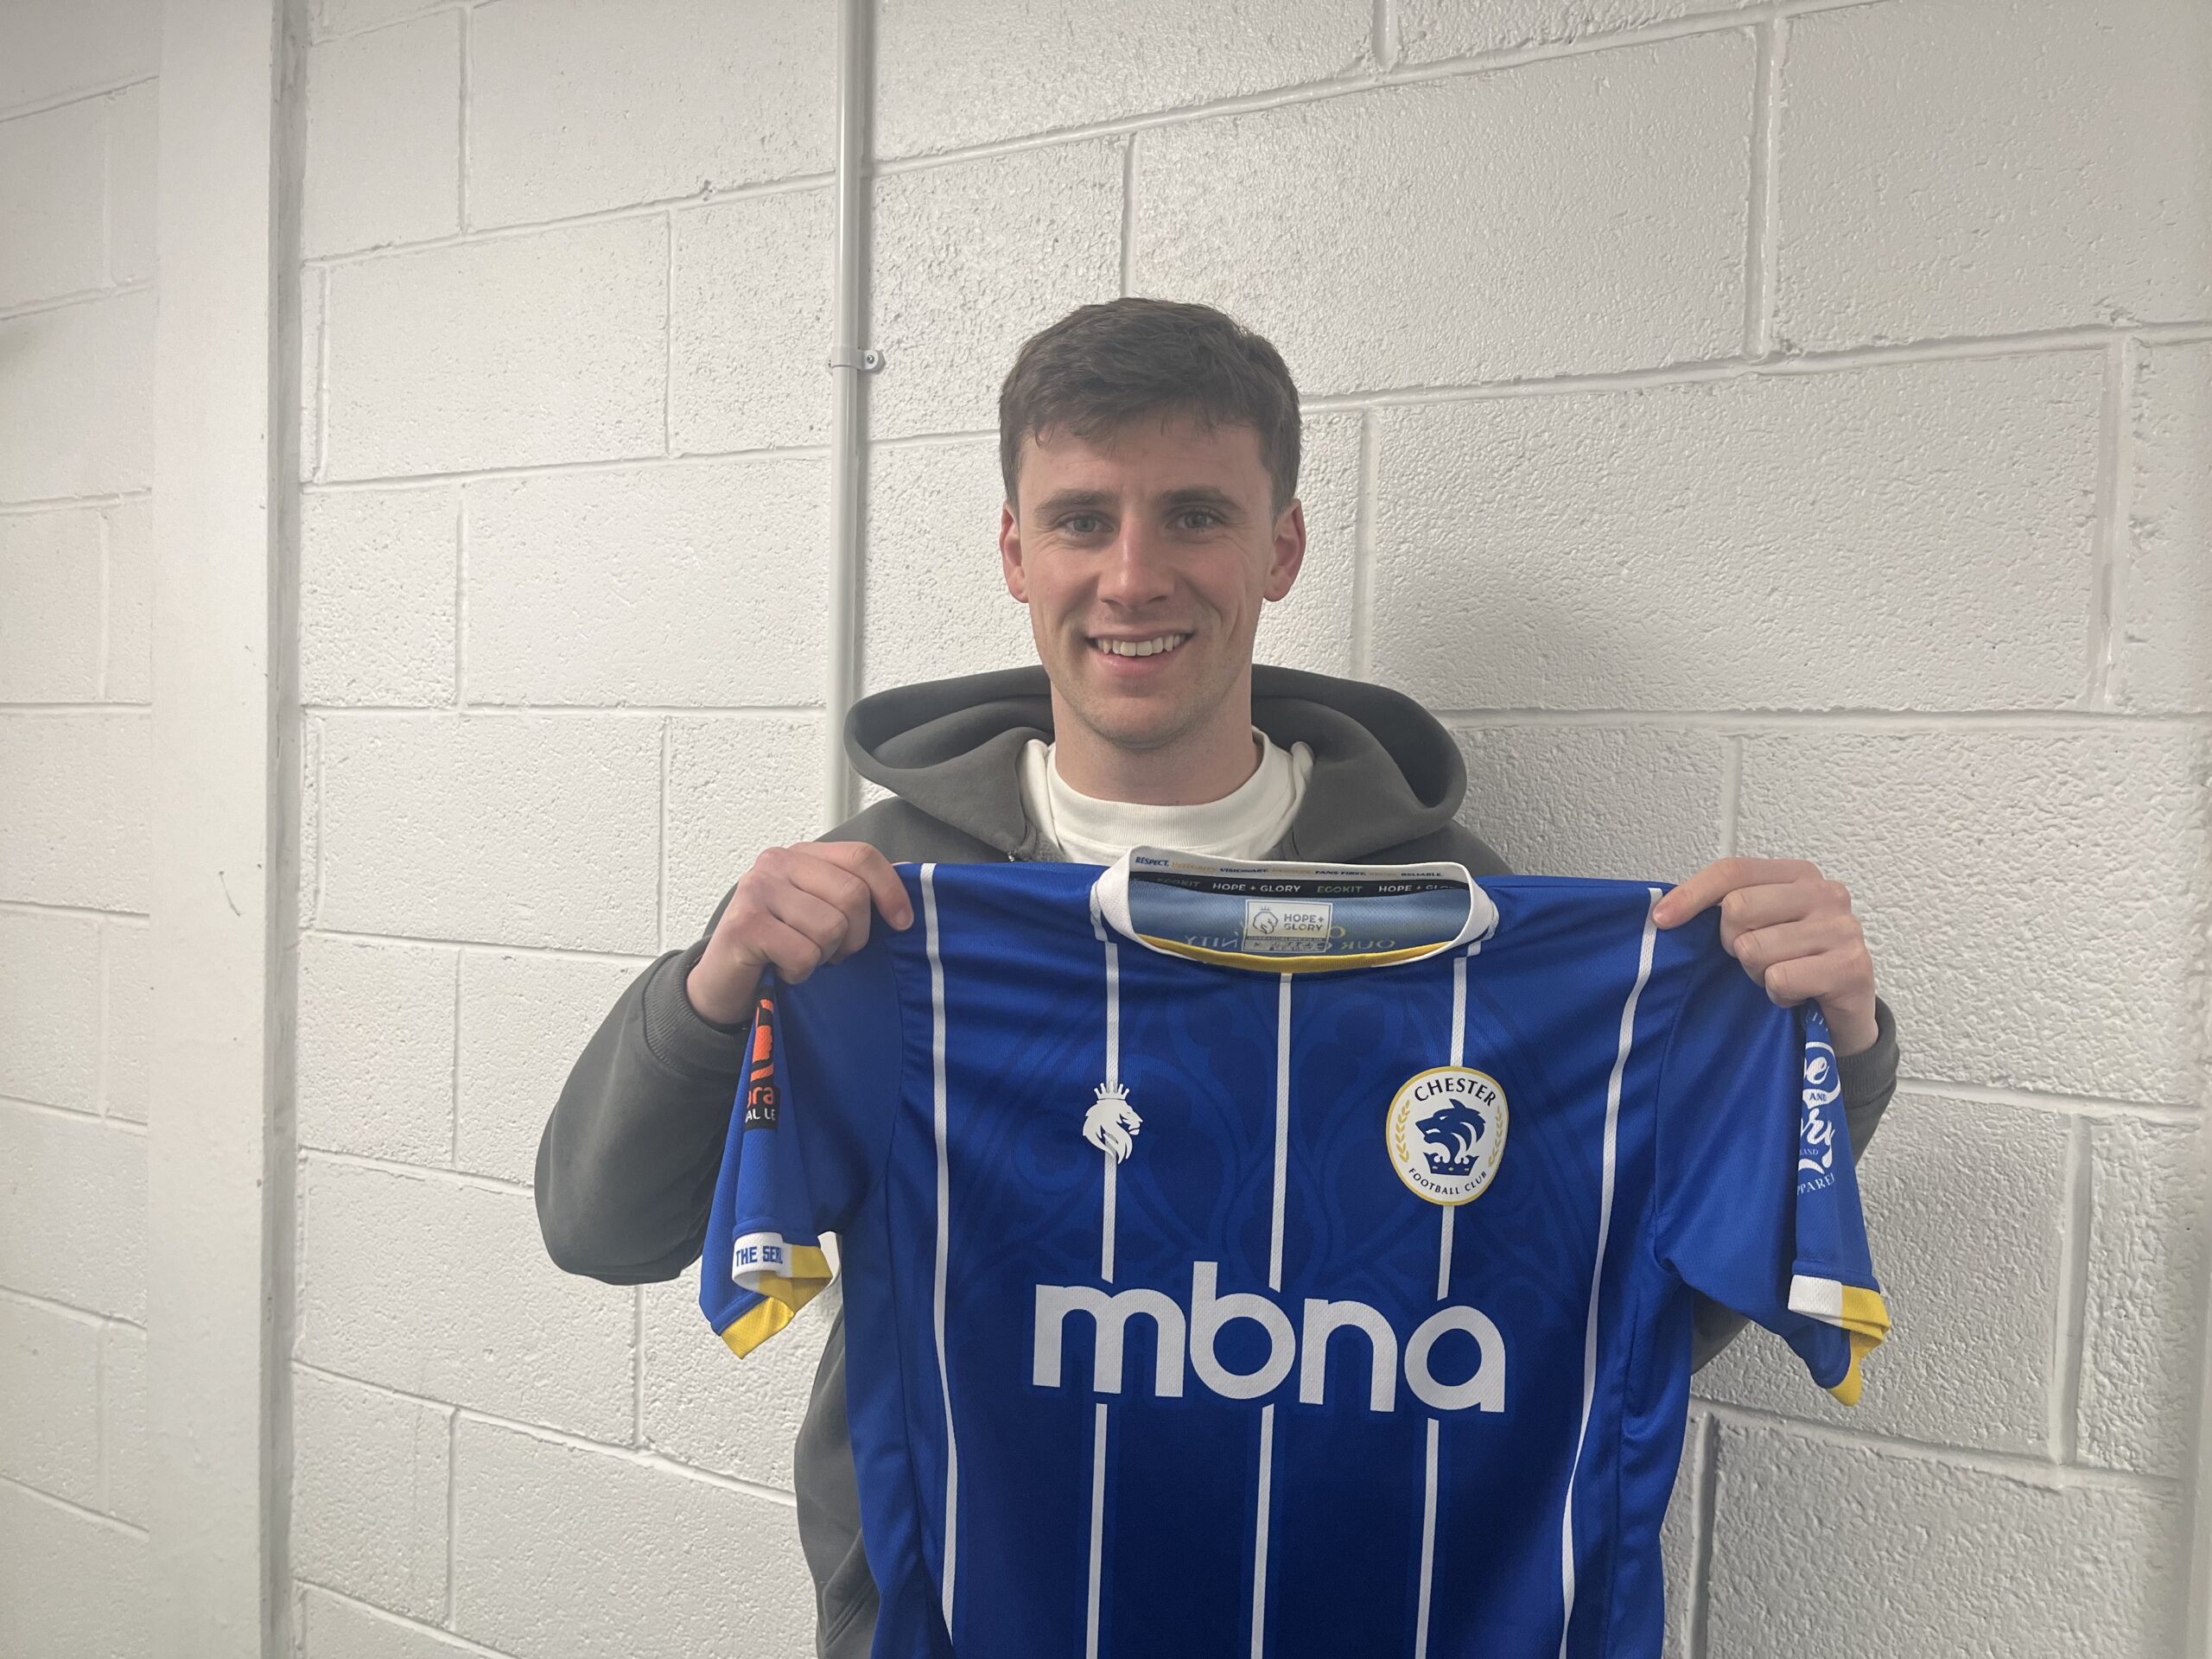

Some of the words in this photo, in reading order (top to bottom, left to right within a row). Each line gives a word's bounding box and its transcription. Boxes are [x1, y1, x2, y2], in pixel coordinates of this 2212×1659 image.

[1212, 882, 1246, 892] HOPE
[1284, 924, 1323, 932] GLORY
[1414, 1077, 1497, 1107] CHESTER
[1408, 1167, 1460, 1194] FOOTBALL
[1465, 1170, 1487, 1192] CLUB
[735, 1245, 758, 1268] THE
[1033, 1261, 1506, 1412] mbna
